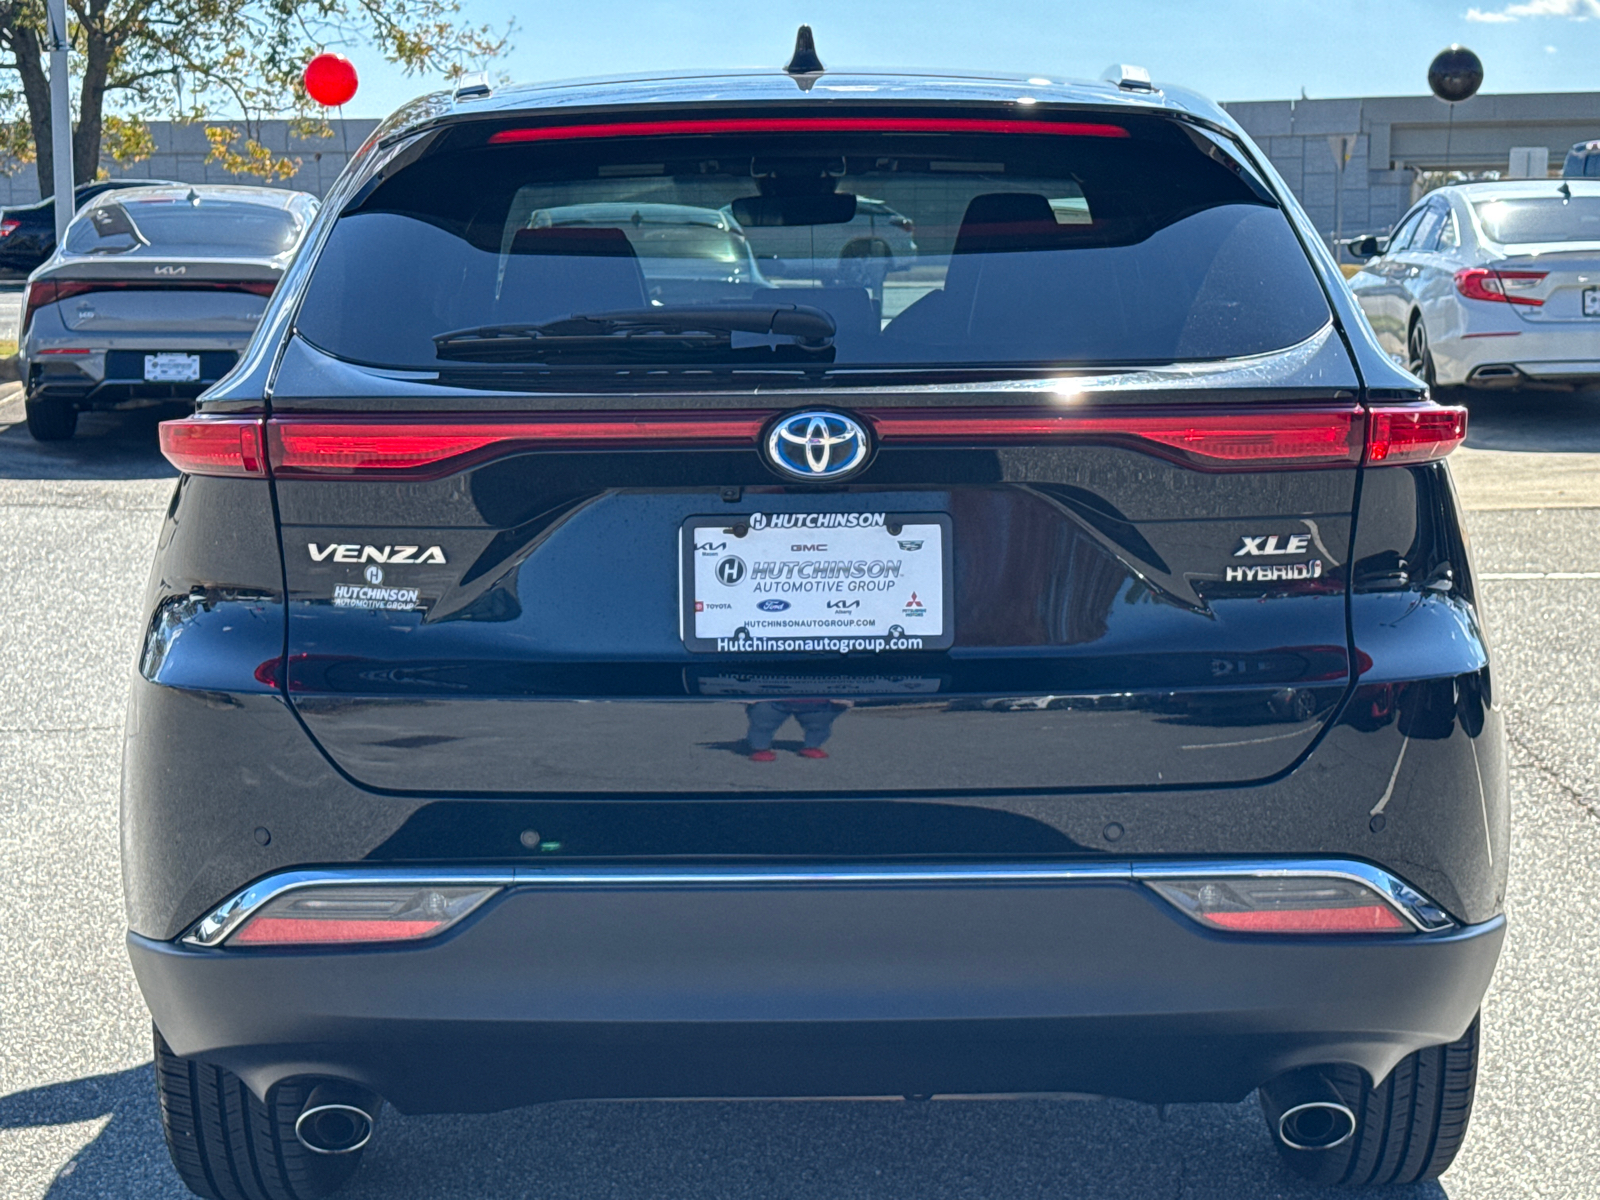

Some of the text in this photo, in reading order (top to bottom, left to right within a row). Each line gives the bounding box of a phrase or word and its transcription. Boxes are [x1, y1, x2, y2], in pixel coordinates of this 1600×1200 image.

[770, 513, 885, 528] HUTCHINSON
[790, 543, 828, 552] GMC
[1233, 534, 1311, 556] XLE
[308, 543, 446, 564] VENZA
[750, 560, 902, 580] HUTCHINSON
[1226, 564, 1308, 581] HYBRID
[334, 586, 419, 602] HUTCHINSON
[753, 580, 895, 593] AUTOMOTIVE GROUP
[334, 599, 386, 608] AUTOMOTIVE
[763, 601, 784, 611] Ford
[744, 619, 876, 629] HUTCHINSONAUTOGROUP.COM
[717, 637, 923, 653] Hutchinsonautogroup.com
